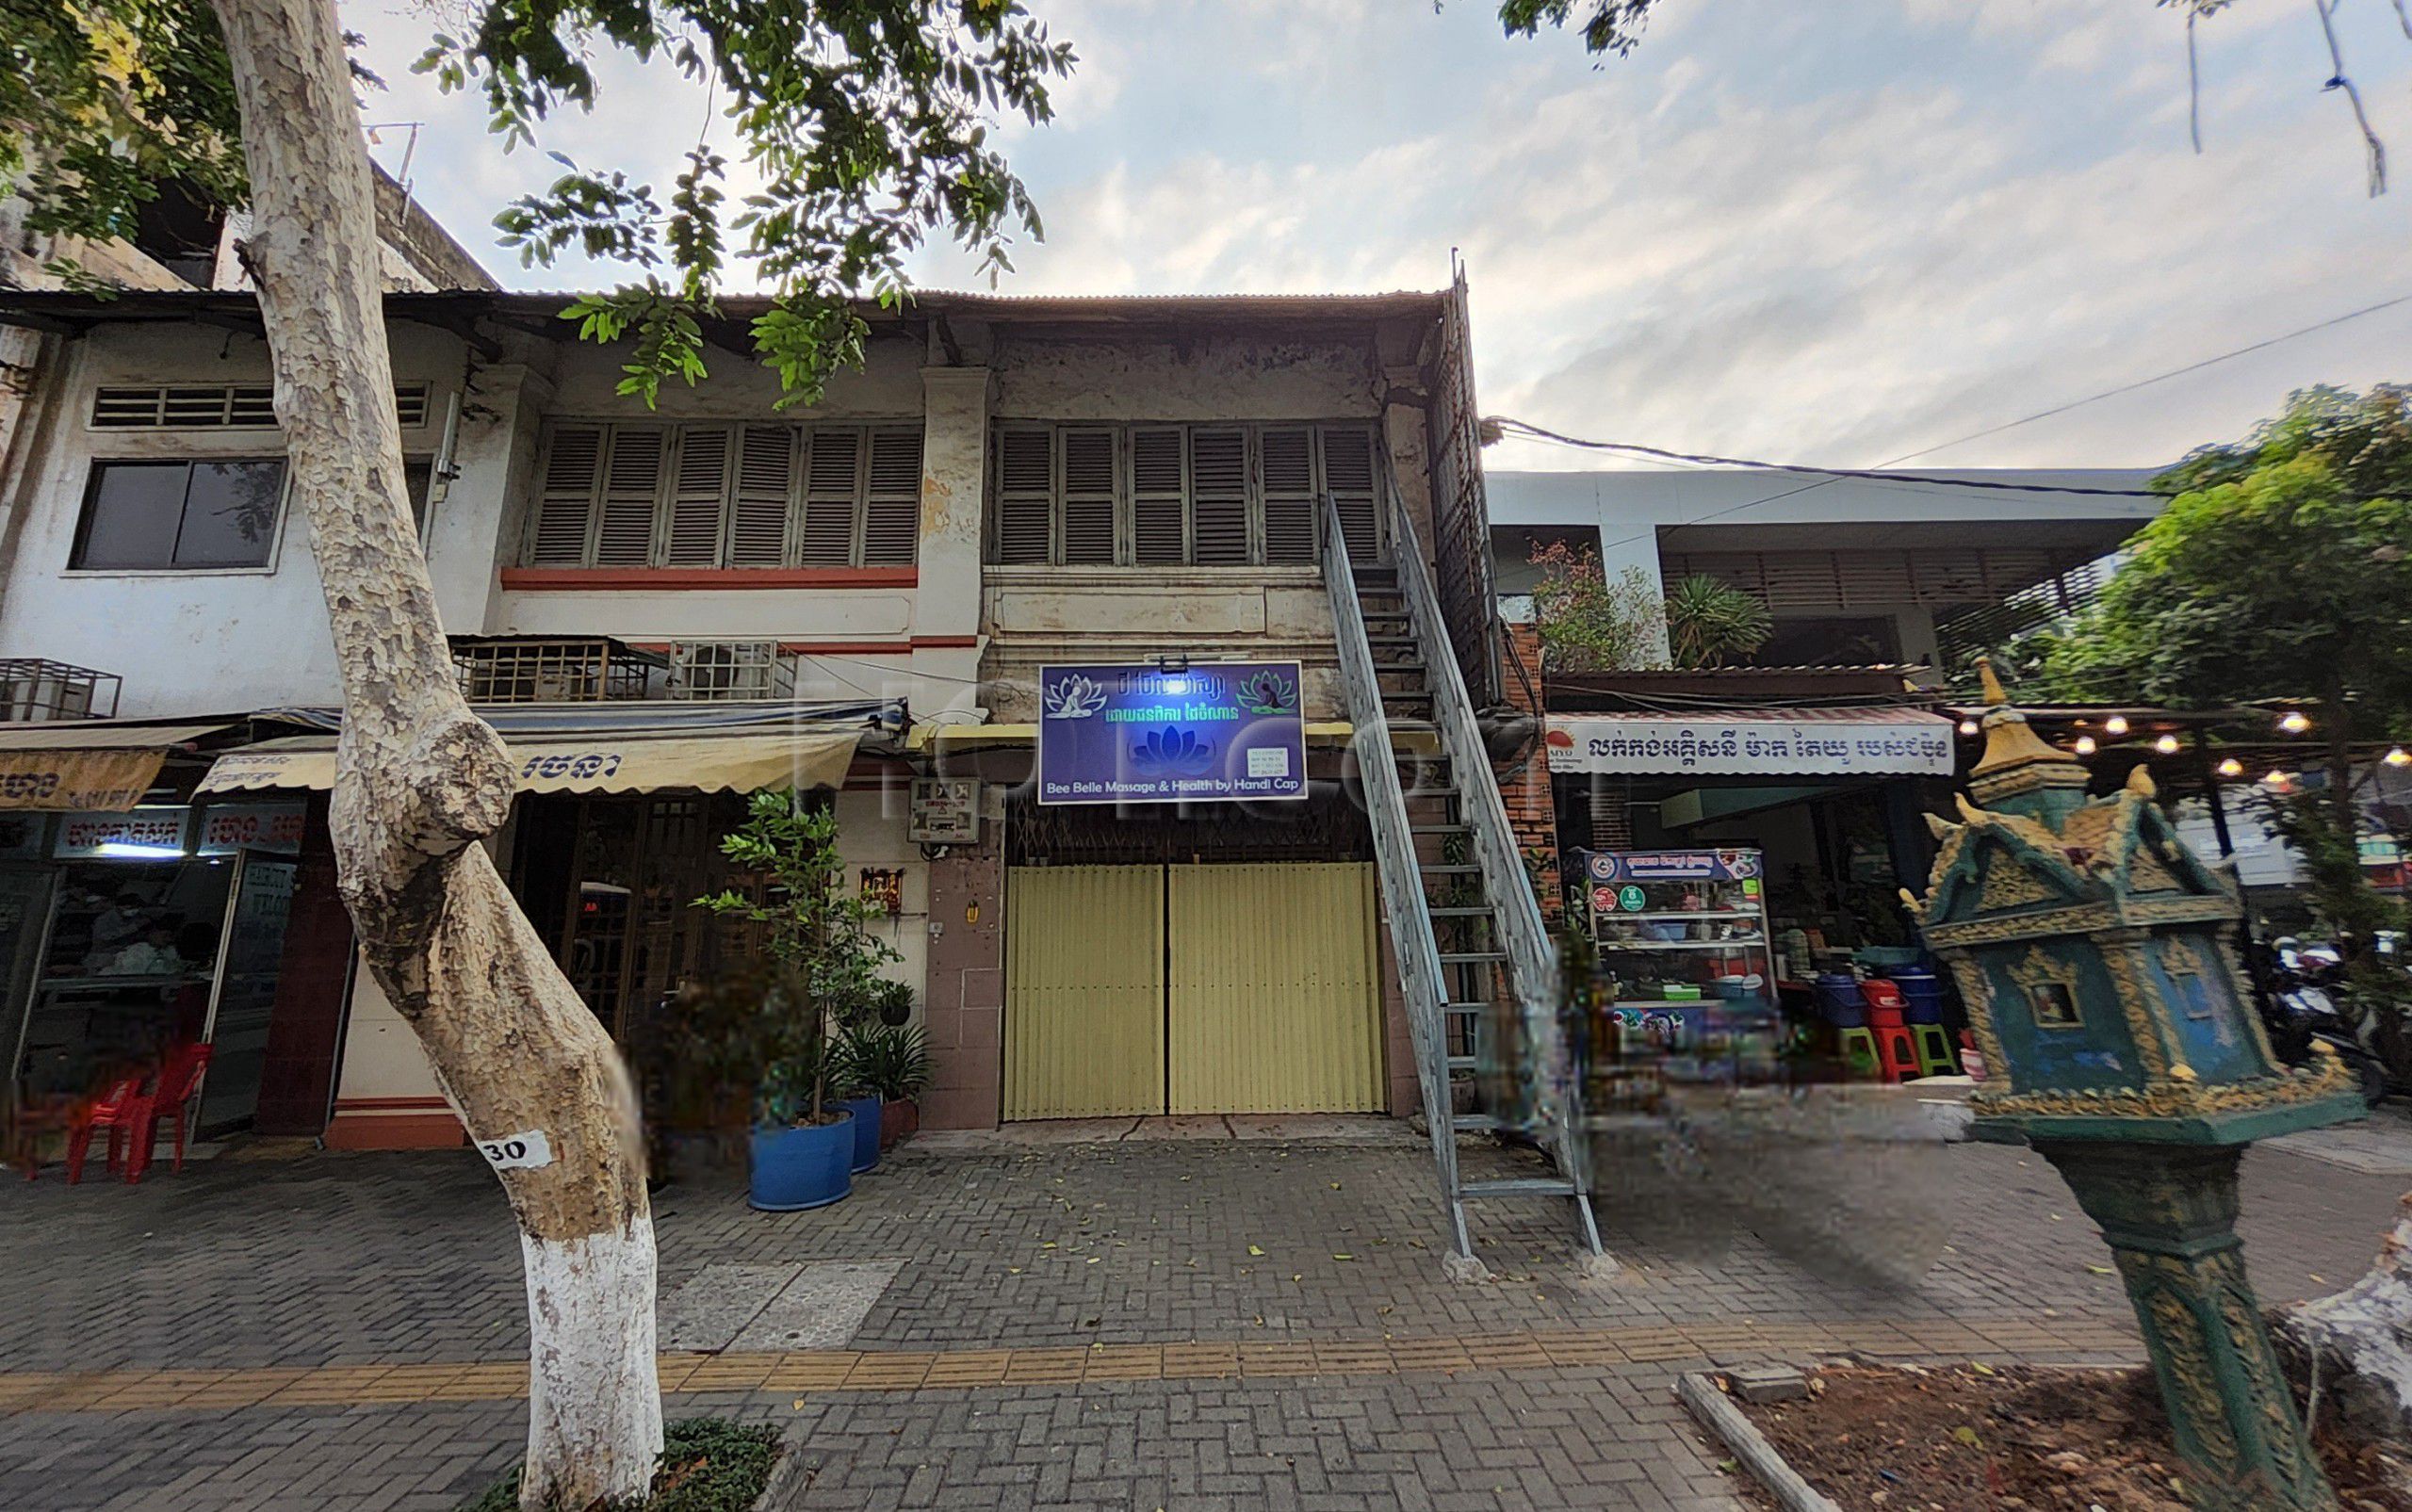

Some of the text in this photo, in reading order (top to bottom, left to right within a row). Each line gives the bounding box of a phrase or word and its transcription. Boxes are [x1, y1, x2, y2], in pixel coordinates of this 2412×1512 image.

[1047, 777, 1299, 794] Bee Belle Massage & Health by Handi Cap
[483, 1141, 526, 1162] 30
